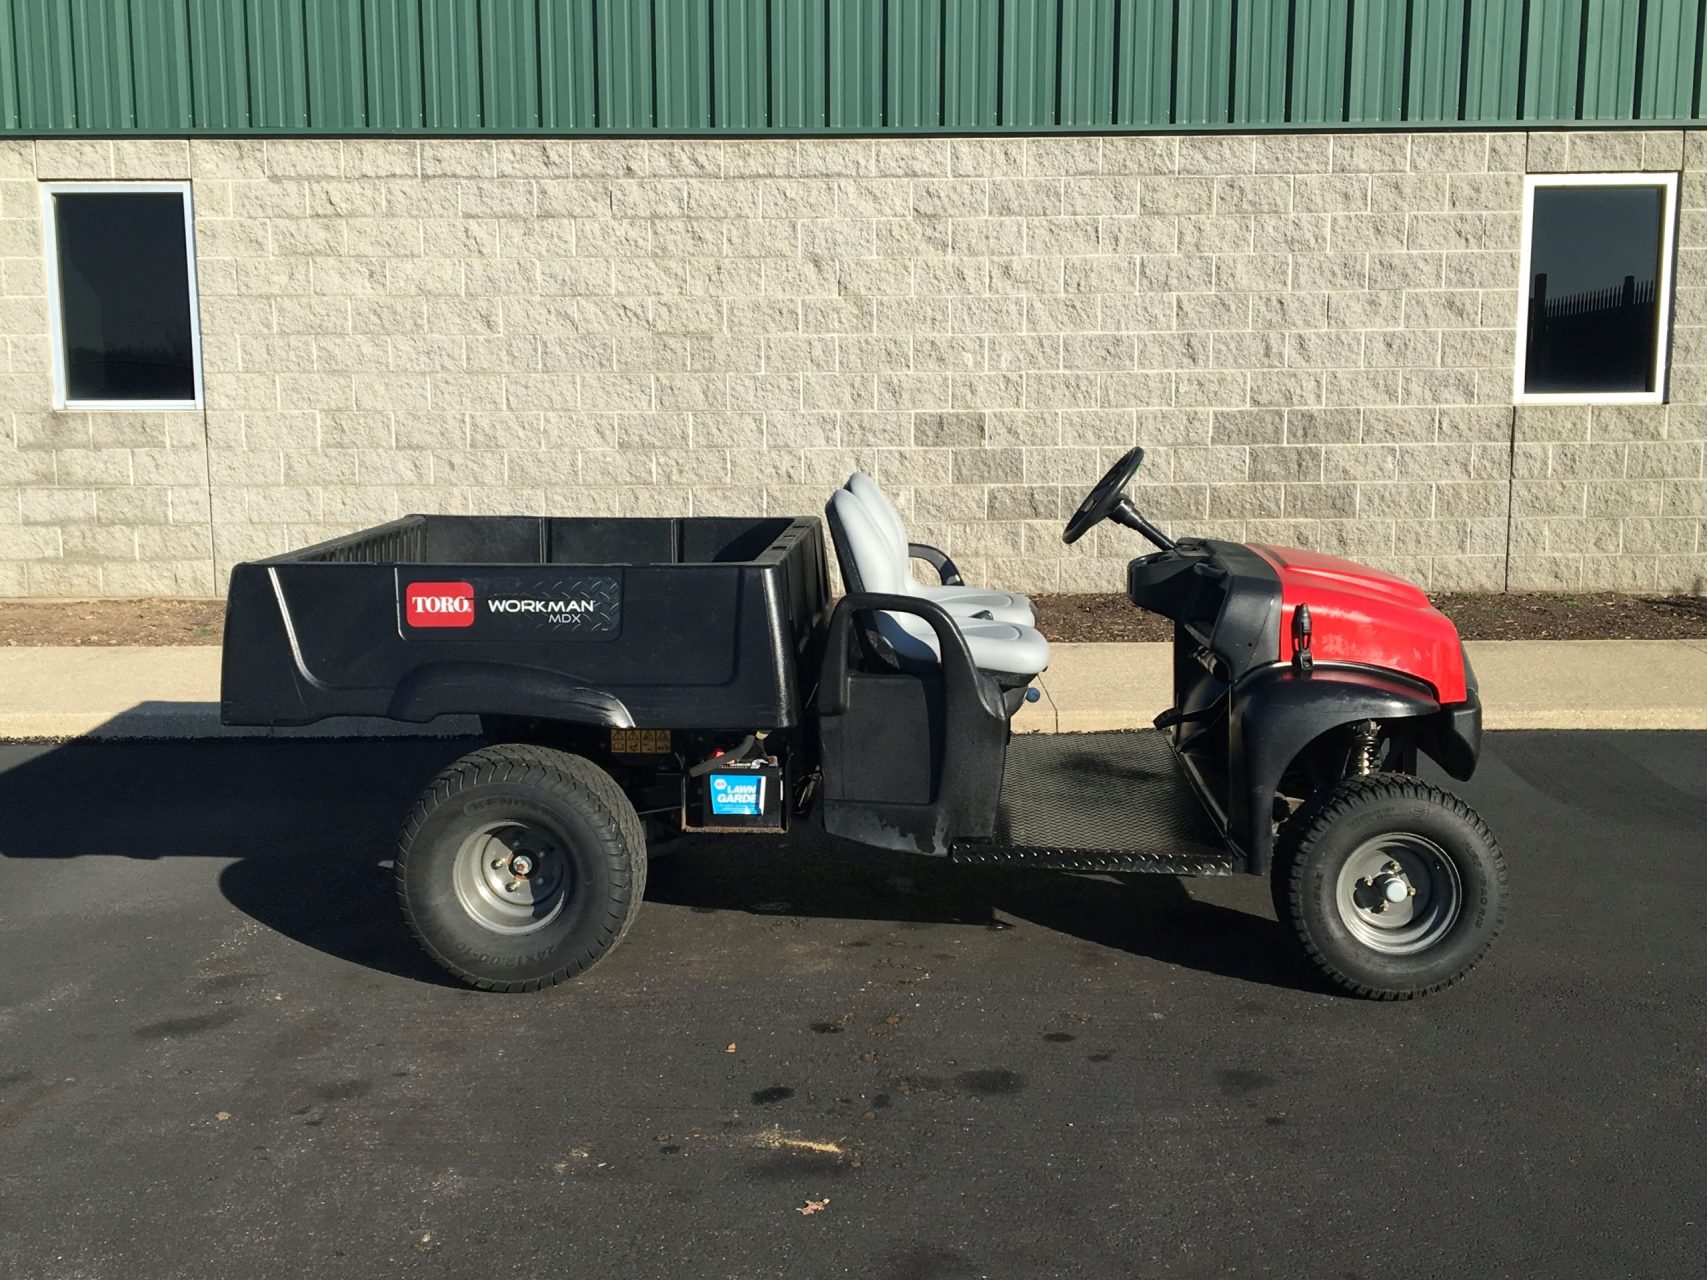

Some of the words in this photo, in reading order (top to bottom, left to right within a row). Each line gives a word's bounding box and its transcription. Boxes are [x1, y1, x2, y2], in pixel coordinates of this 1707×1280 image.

[412, 596, 469, 613] TORO
[488, 599, 594, 613] WORKMAN
[548, 613, 582, 624] MDX
[727, 785, 757, 794] LAWN
